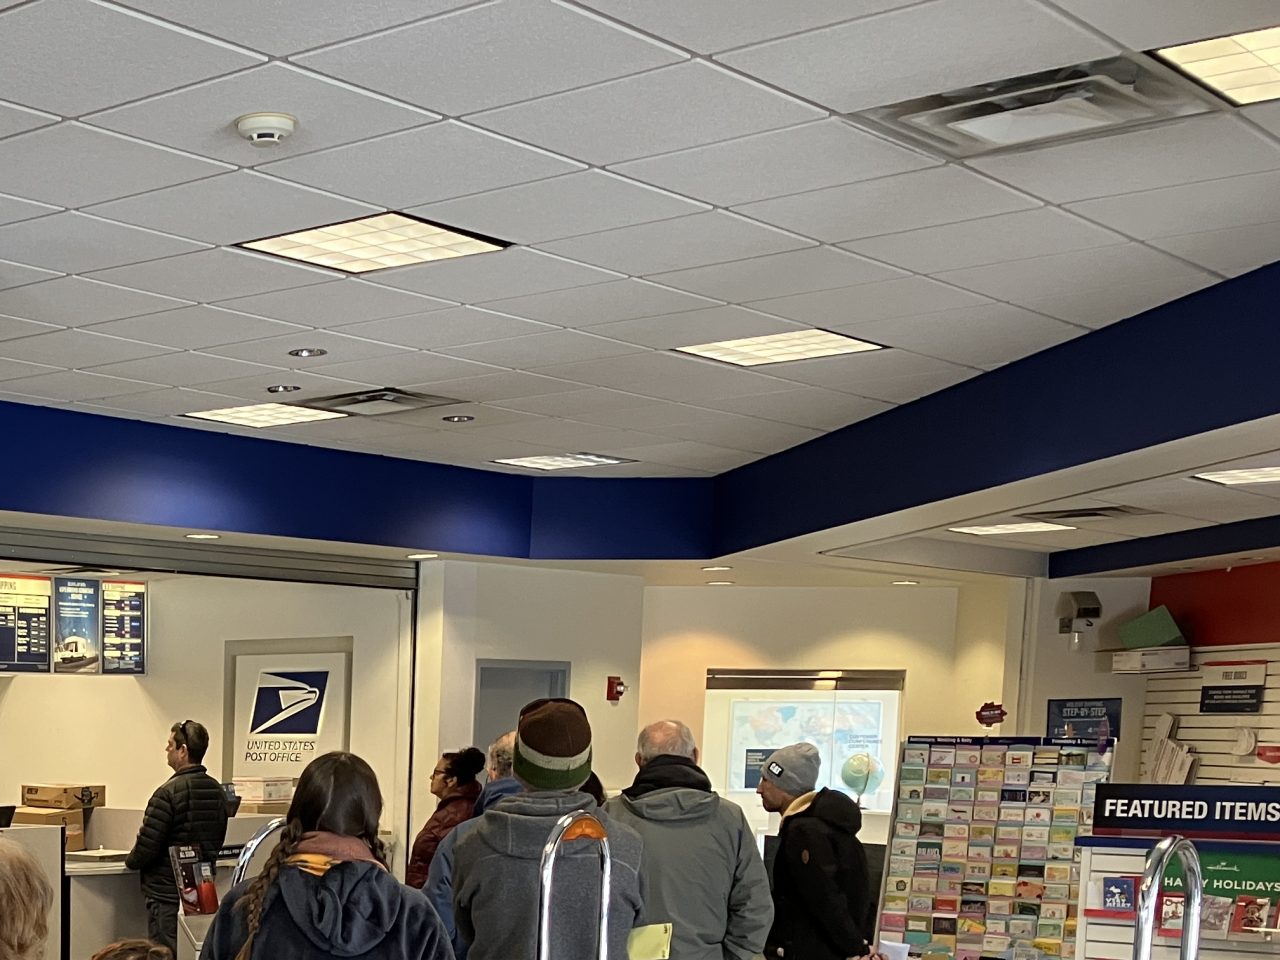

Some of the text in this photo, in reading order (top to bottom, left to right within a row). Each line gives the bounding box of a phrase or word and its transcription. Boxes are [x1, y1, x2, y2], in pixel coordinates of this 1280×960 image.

[1062, 707, 1106, 717] STEP-BY-STEP
[246, 740, 315, 750] UNITED STATES
[244, 752, 302, 762] POST OFFICE
[1104, 798, 1280, 822] FEATURED ITEMS
[1164, 876, 1280, 892] HAY HOLIDAYS
